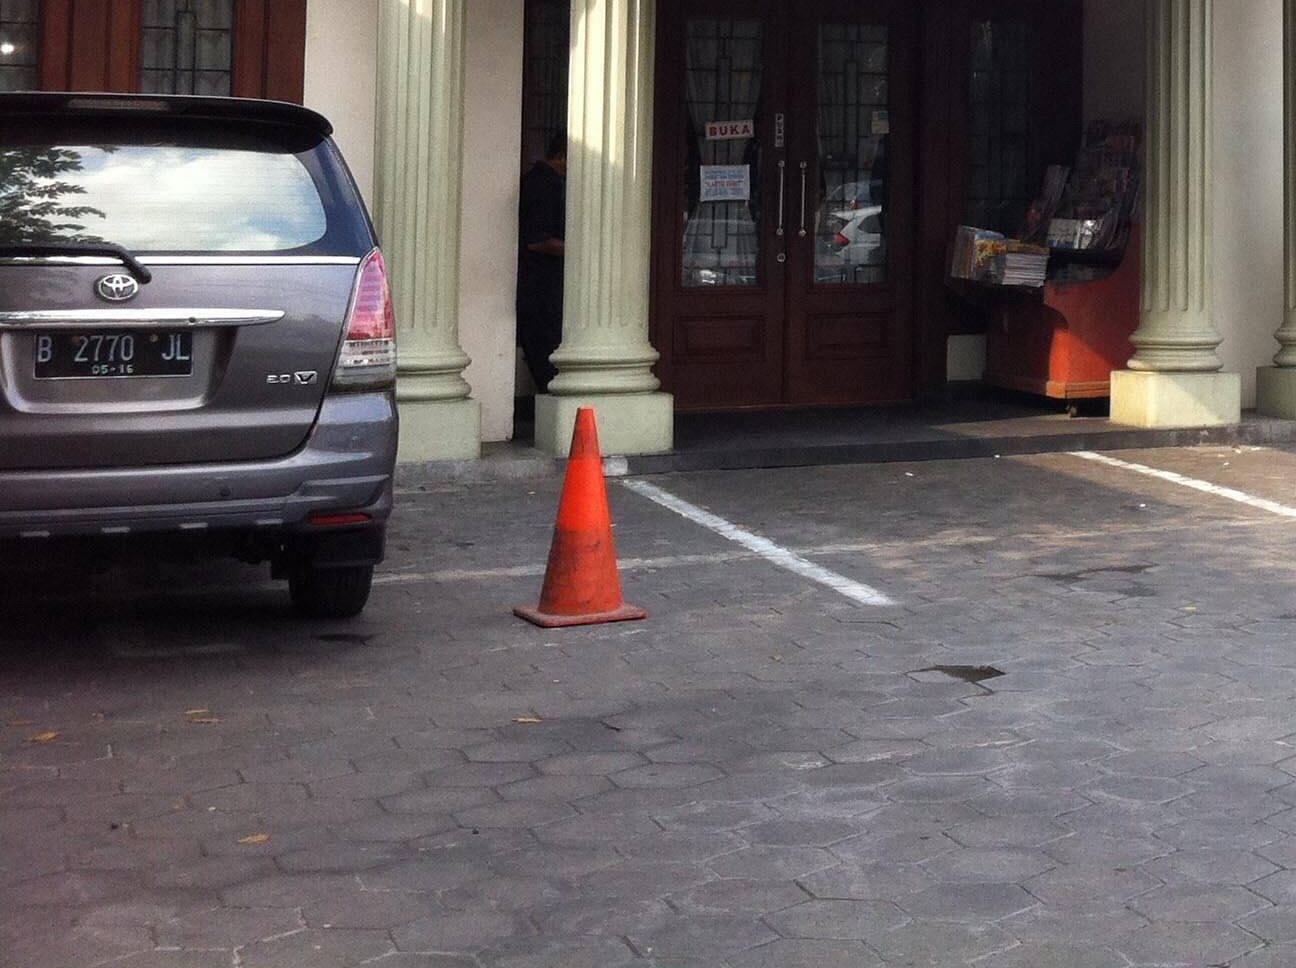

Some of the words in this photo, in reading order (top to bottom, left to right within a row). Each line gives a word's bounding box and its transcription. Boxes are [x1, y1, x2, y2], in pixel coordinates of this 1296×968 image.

[709, 124, 751, 137] BUKA
[37, 336, 52, 362] B
[74, 335, 134, 362] 2770
[161, 334, 190, 361] JL
[92, 363, 134, 375] 05-16
